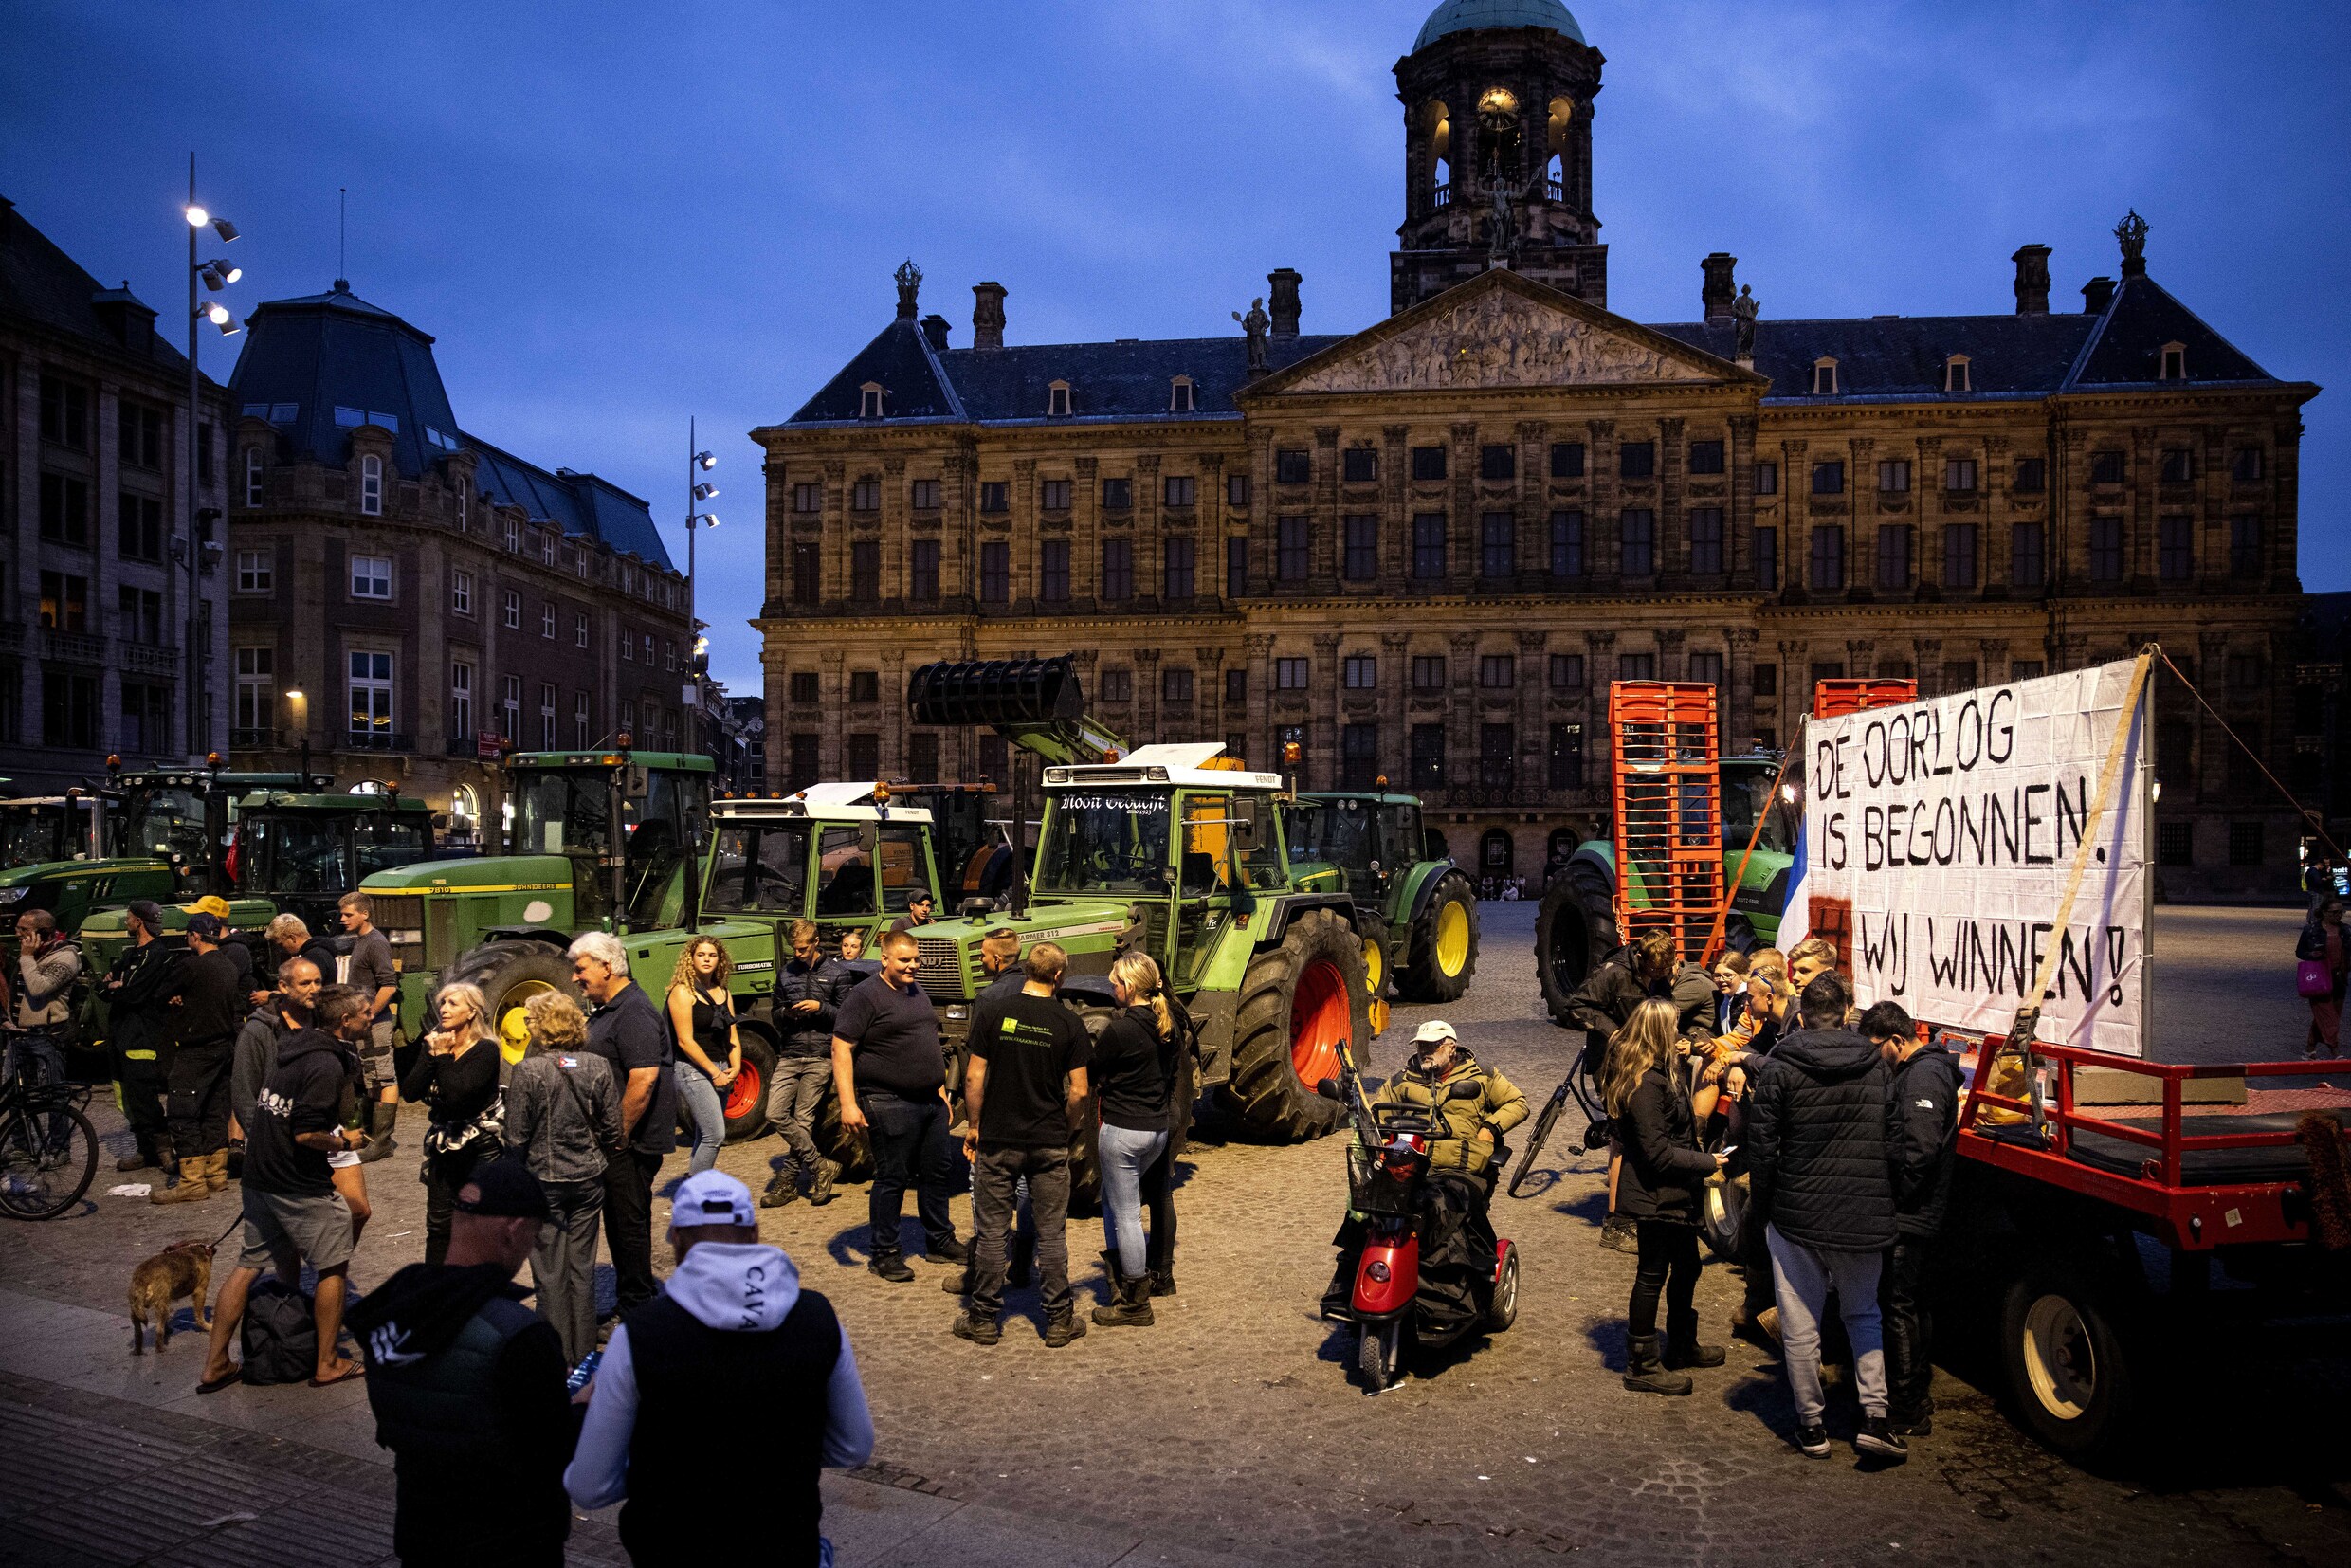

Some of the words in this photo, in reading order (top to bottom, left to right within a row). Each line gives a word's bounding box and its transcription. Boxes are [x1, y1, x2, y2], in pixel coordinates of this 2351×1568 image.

[1255, 775, 1276, 783] FENDT
[1816, 735, 1850, 801] DE
[1863, 689, 2014, 788] OORLOG
[1822, 812, 1847, 870] IS
[1865, 776, 2106, 872] BEGONNEN.
[429, 886, 451, 895] 7810
[1862, 908, 1908, 996] WIJ
[1928, 916, 2125, 1008] WINNEN!
